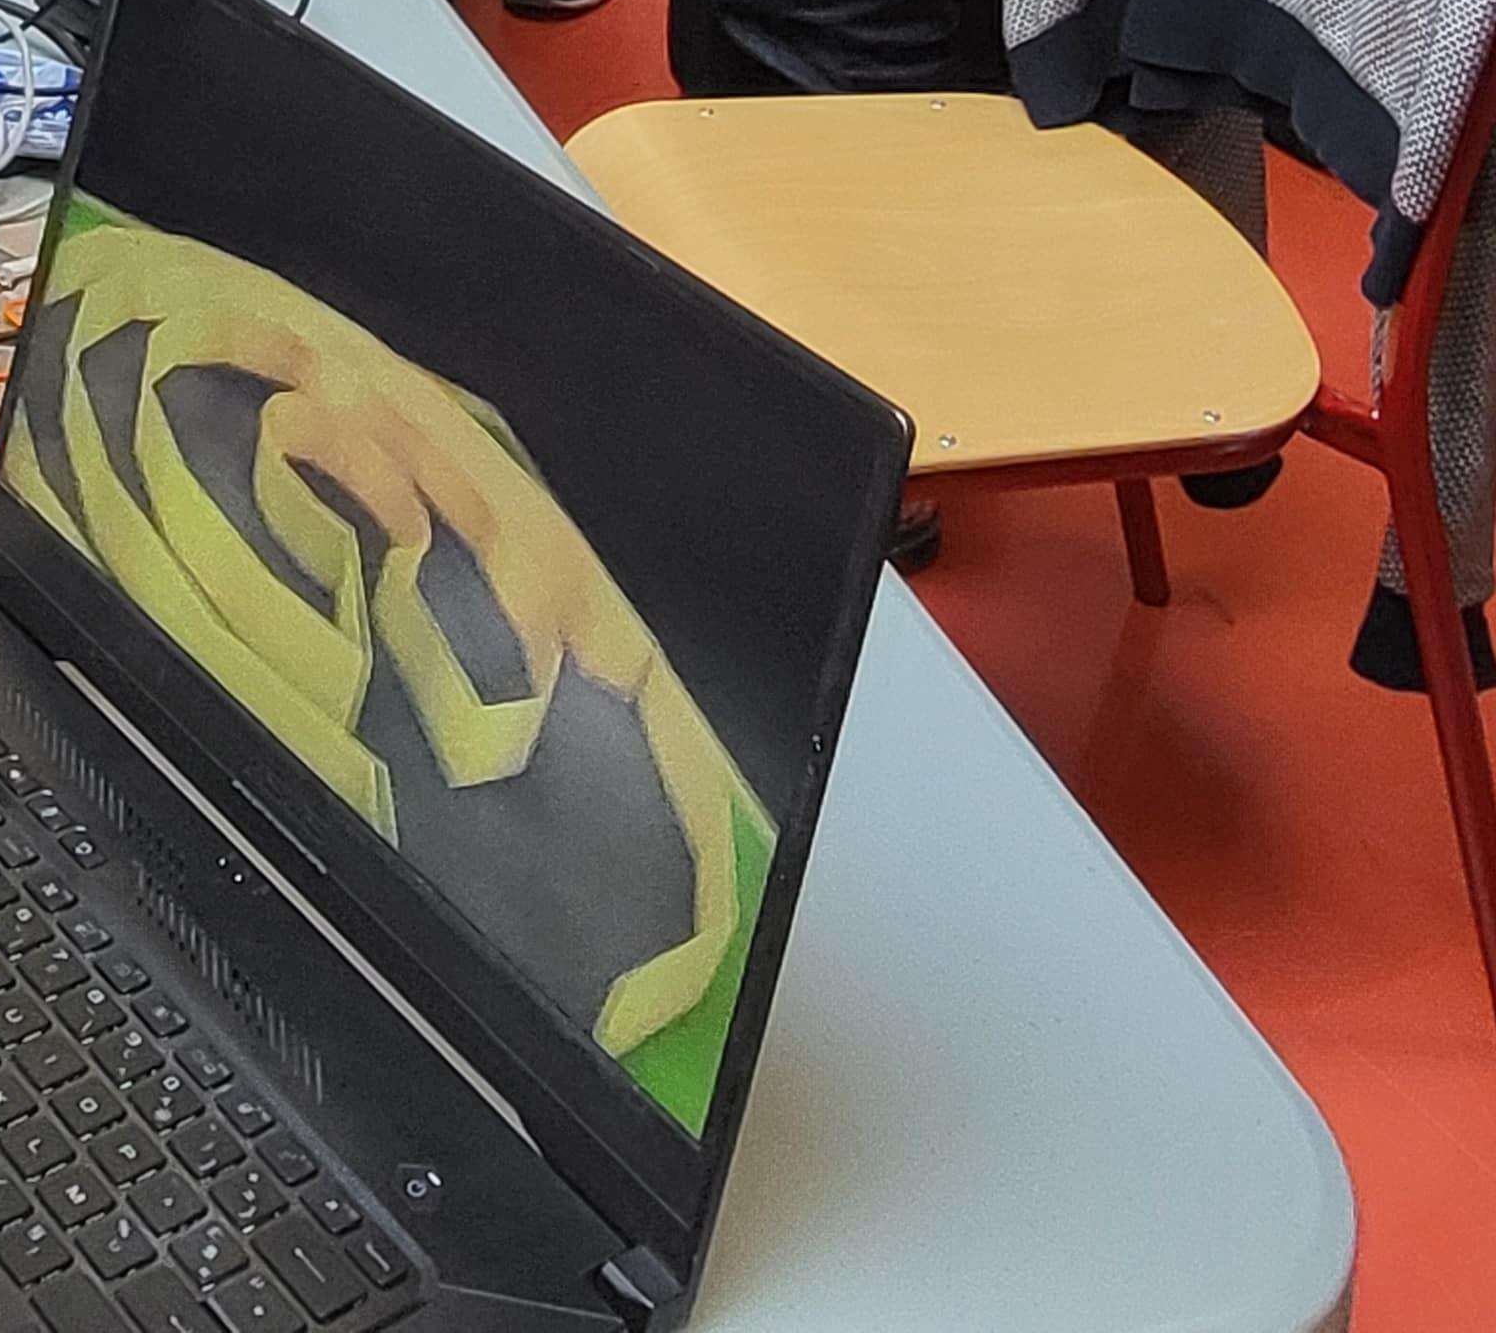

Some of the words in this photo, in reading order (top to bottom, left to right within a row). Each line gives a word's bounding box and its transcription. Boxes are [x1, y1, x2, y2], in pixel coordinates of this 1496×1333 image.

[52, 948, 70, 961] 7
[124, 1033, 143, 1047] 9
[4, 1007, 24, 1023] U
[118, 1144, 136, 1160] P
[27, 1138, 41, 1154] L
[65, 1184, 87, 1205] M
